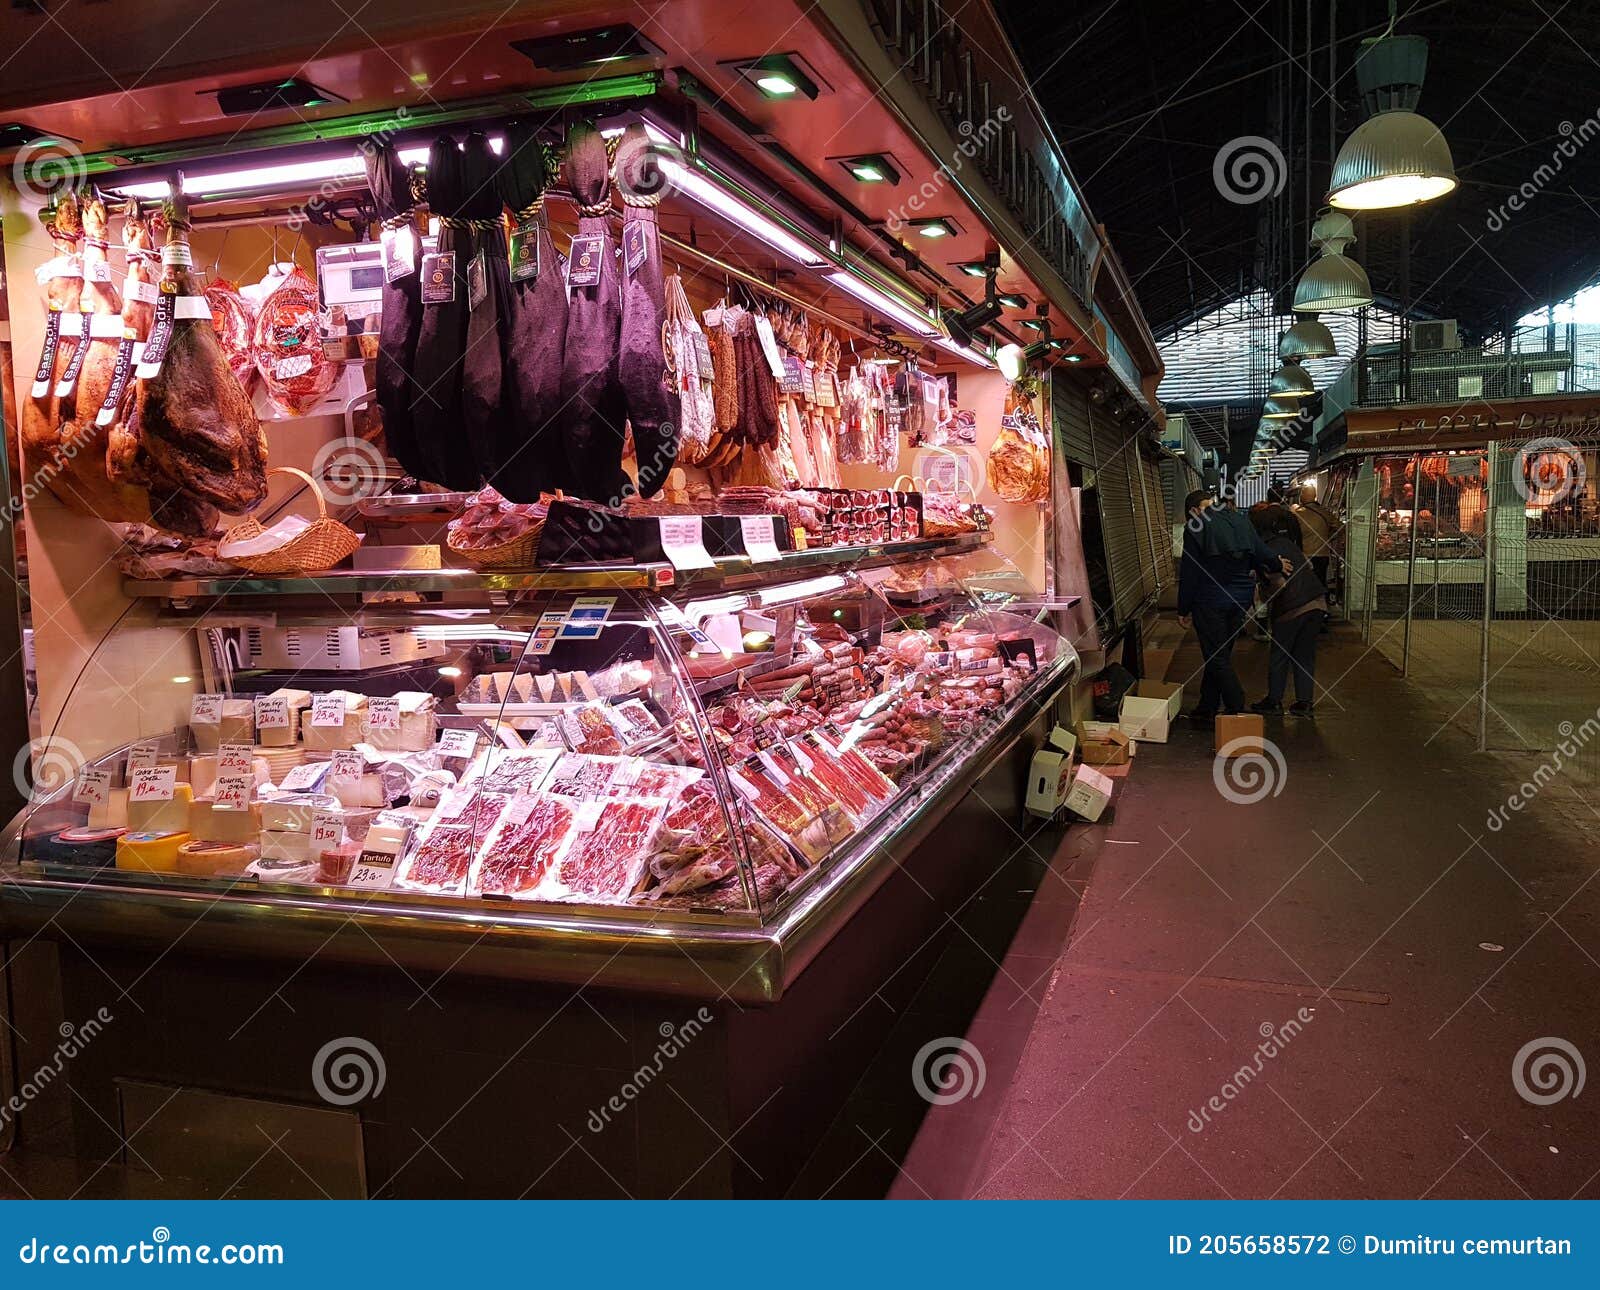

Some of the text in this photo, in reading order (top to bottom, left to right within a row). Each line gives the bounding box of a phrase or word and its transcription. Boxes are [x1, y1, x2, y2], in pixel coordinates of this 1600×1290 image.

[37, 313, 54, 378] Saavedra
[64, 314, 86, 379] Saaved
[144, 296, 166, 360] Saavedra
[363, 854, 392, 863] Tartufo
